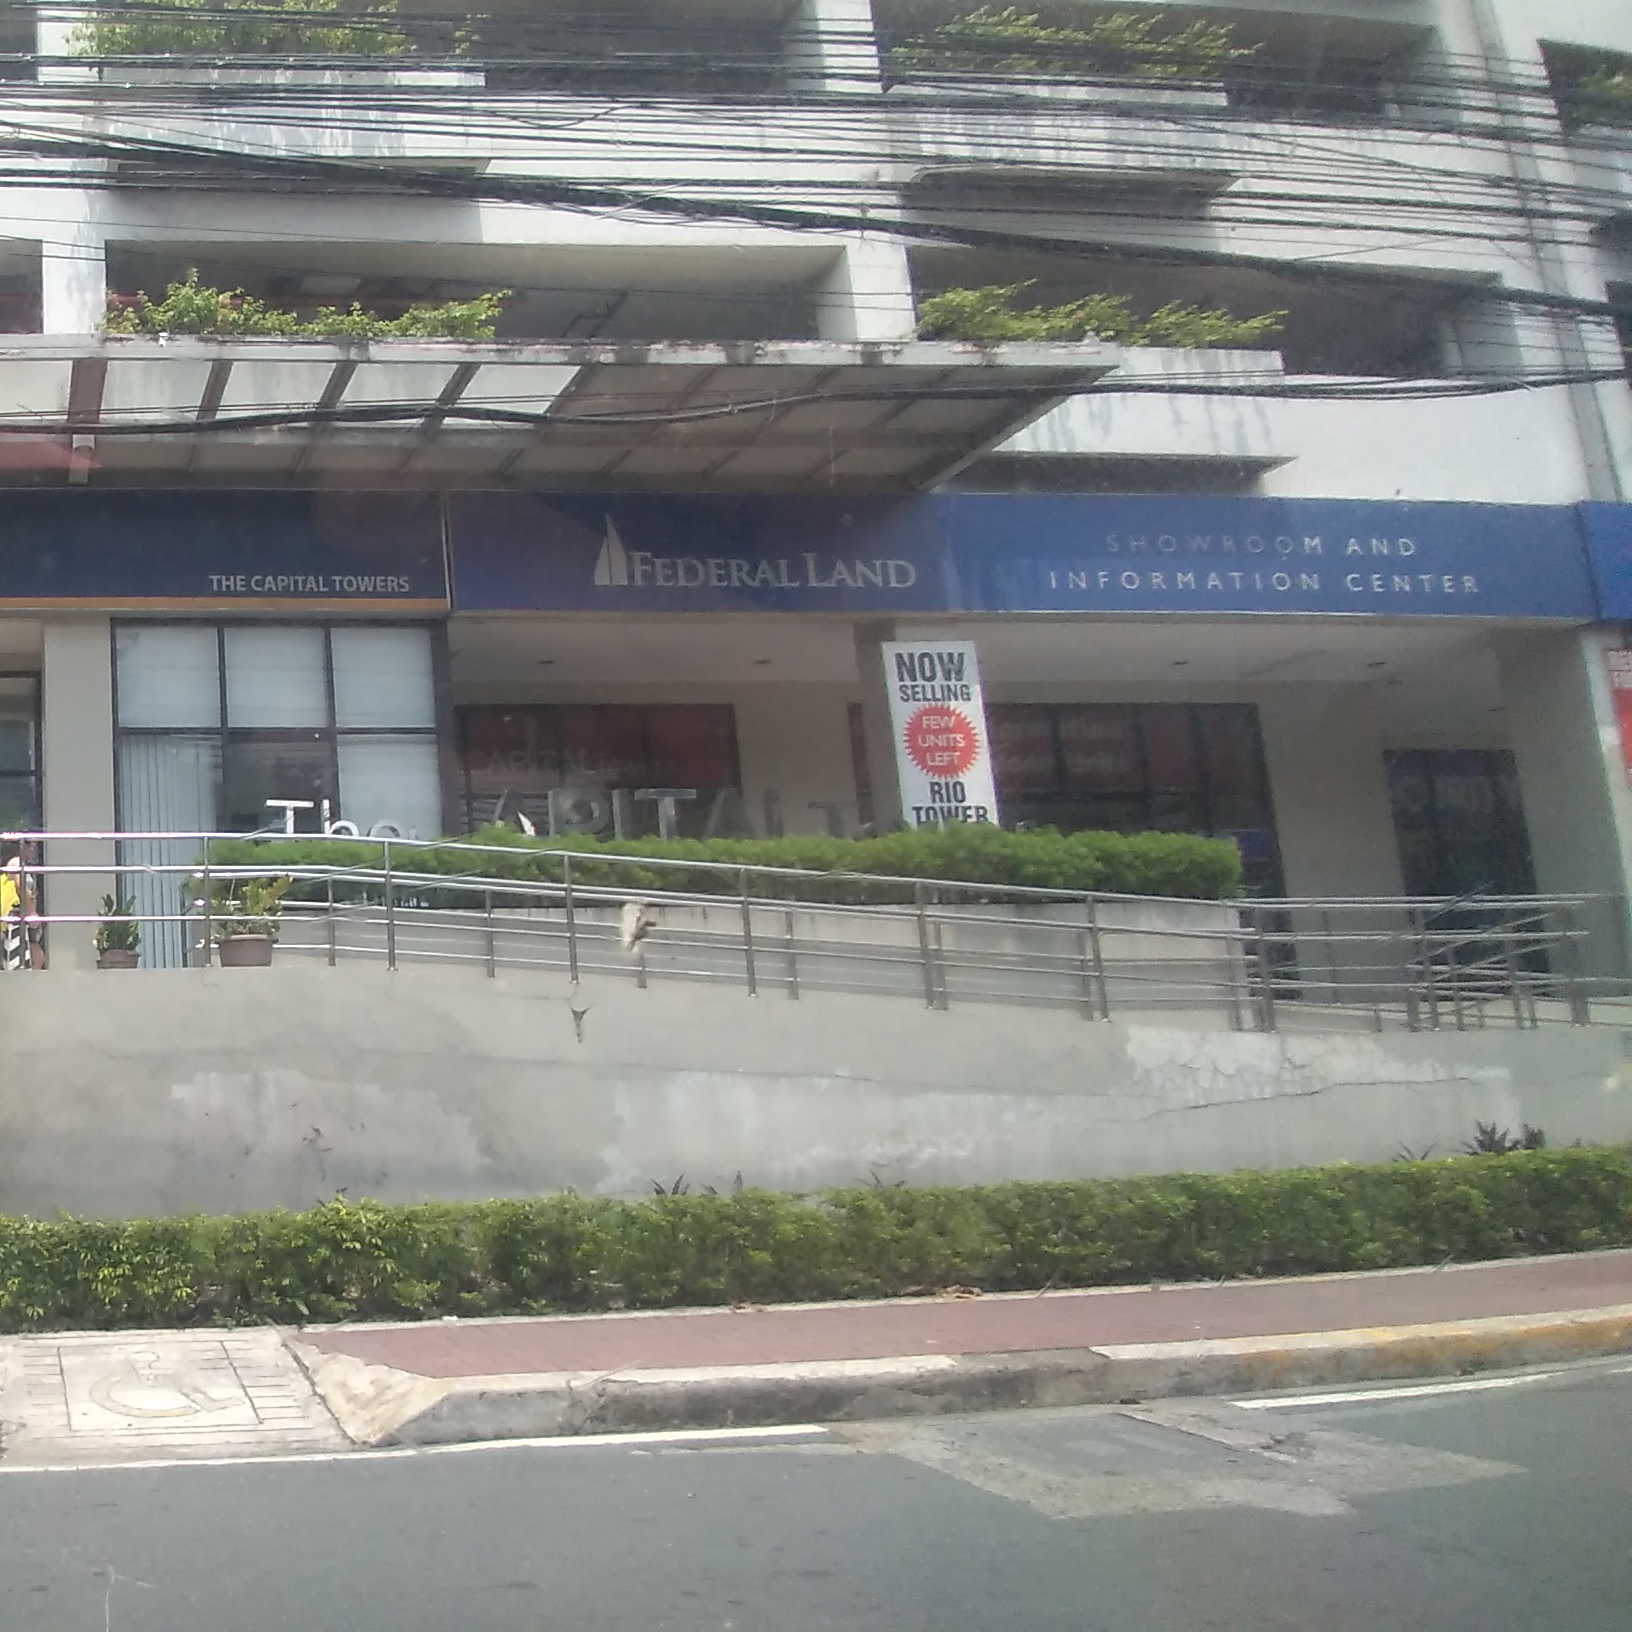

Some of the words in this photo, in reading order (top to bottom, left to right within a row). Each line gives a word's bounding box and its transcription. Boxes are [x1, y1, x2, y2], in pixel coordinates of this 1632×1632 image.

[1106, 533, 1323, 555] SHOWROOM
[1346, 536, 1417, 557] AND
[628, 552, 800, 588] FEDERAL
[803, 552, 917, 588] LAND
[209, 574, 247, 591] THE
[250, 574, 329, 592] CAPITAL
[331, 575, 410, 592] TOWERS
[1050, 570, 1321, 591] INFORMATION
[1345, 573, 1479, 594] CENTER
[894, 652, 965, 683] NOW
[899, 683, 972, 703] SELLING
[922, 715, 956, 730] FEW
[918, 734, 966, 748] UNITS
[925, 751, 962, 767] LEFT
[929, 780, 967, 804] RIO
[911, 805, 990, 823] TOWER
